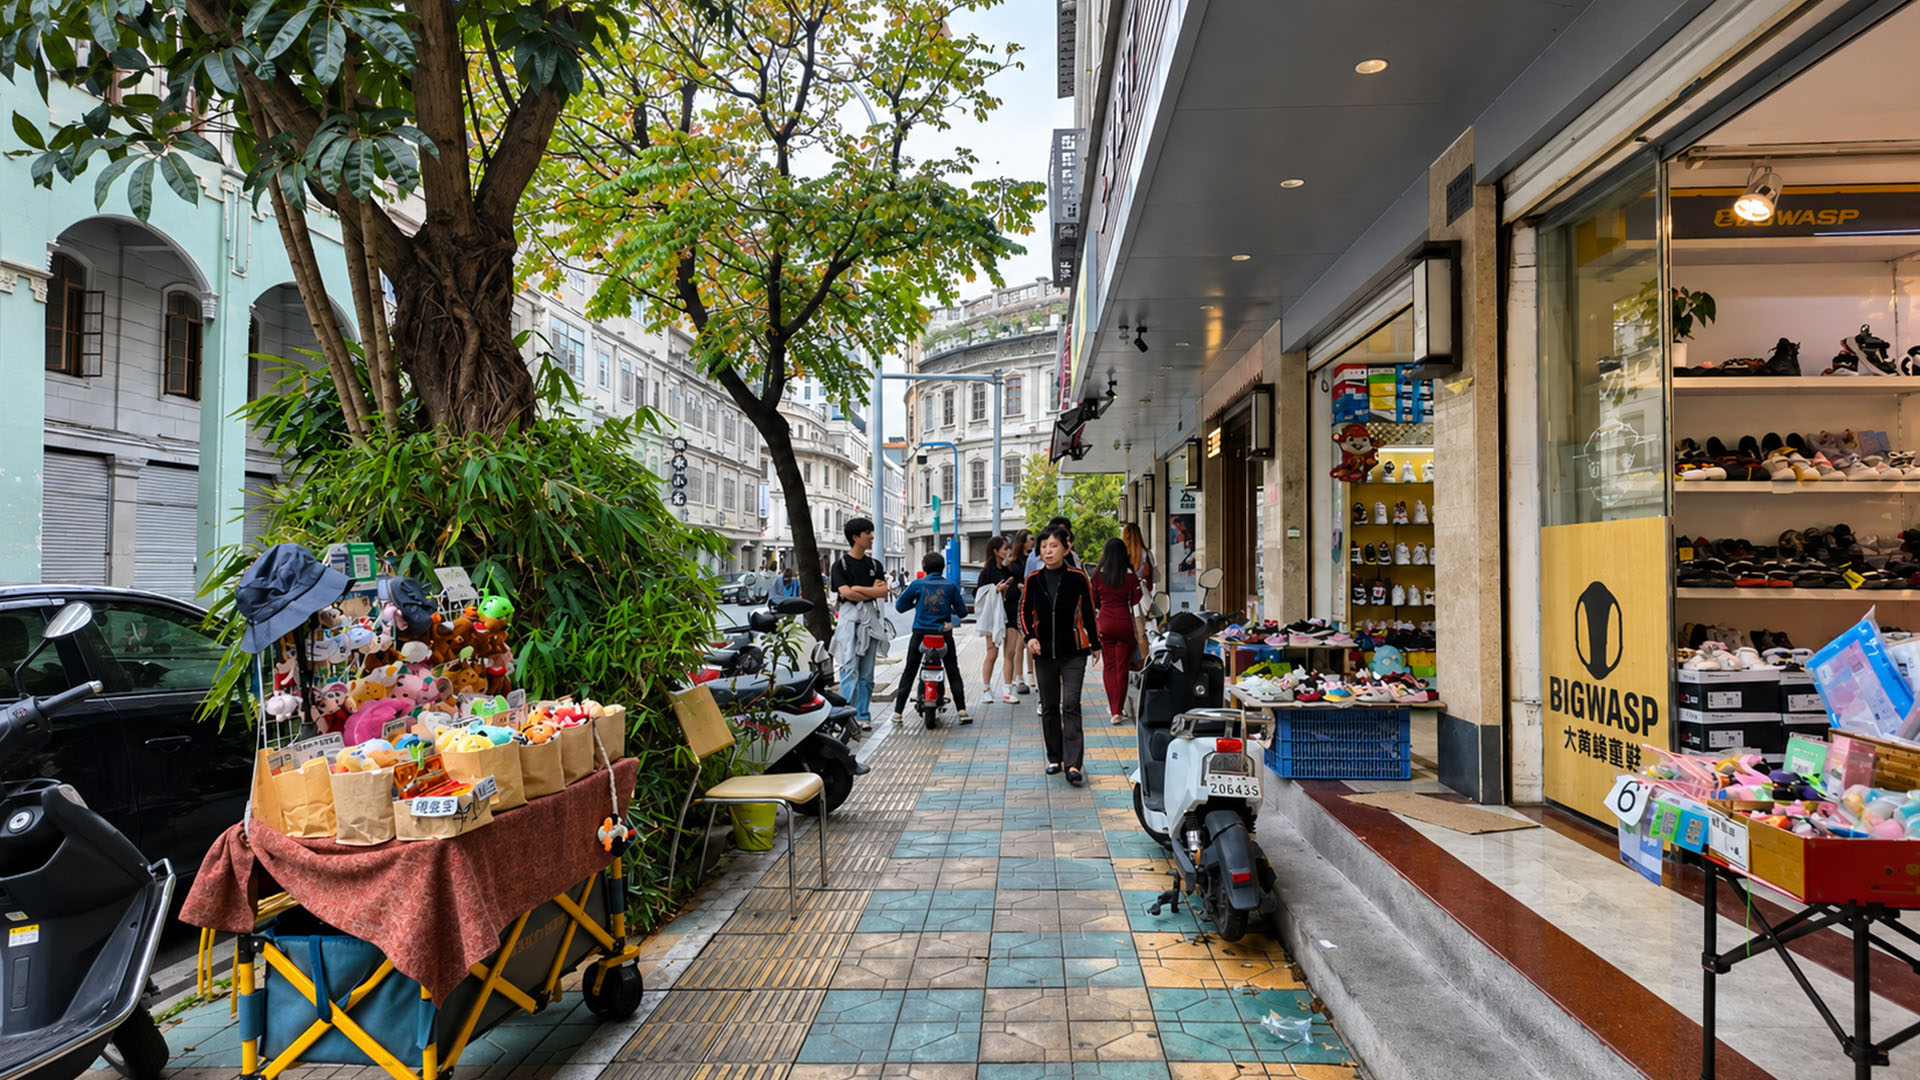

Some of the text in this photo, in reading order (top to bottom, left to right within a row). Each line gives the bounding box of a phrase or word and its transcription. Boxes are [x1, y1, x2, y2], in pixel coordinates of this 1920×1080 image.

[1714, 208, 1860, 227] BWASP
[1549, 675, 1658, 737] BIGWASP
[1617, 780, 1640, 813] 6
